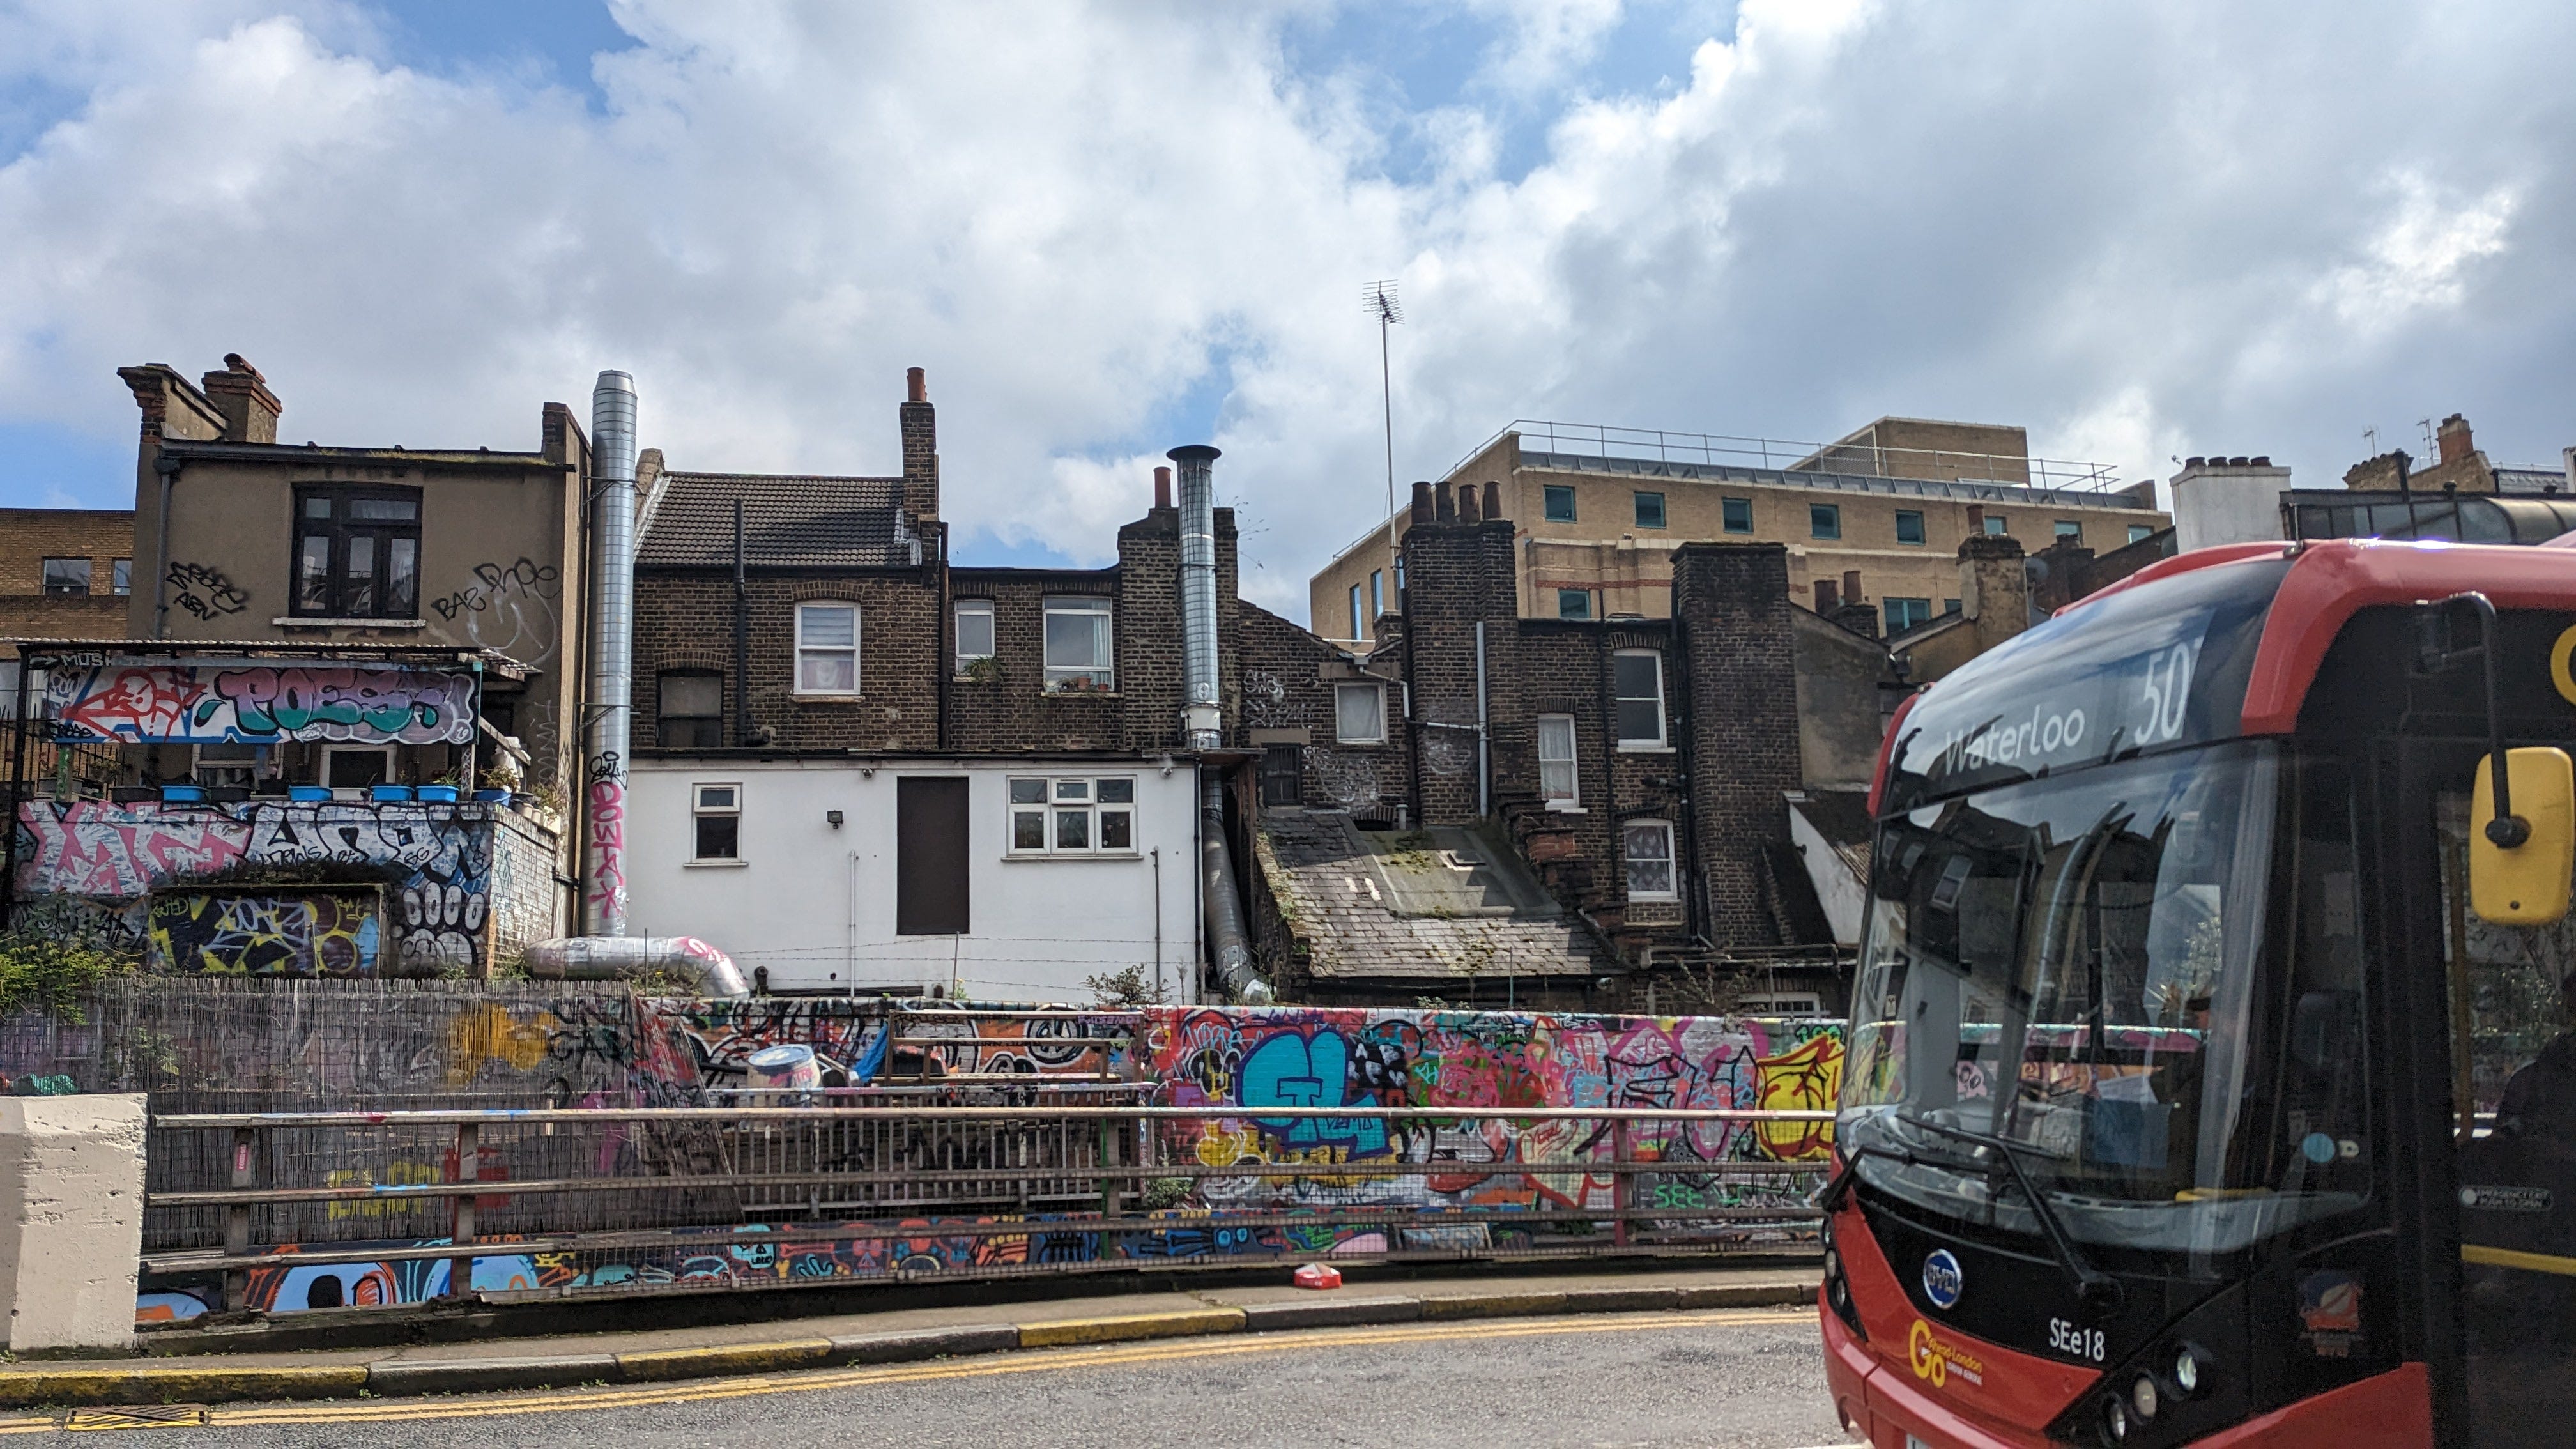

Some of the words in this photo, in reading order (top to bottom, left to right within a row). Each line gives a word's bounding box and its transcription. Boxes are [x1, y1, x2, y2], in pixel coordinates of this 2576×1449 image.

[2135, 636, 2204, 744] 50
[1945, 704, 2085, 776] Waterloo
[2049, 1317, 2105, 1362] SEe18
